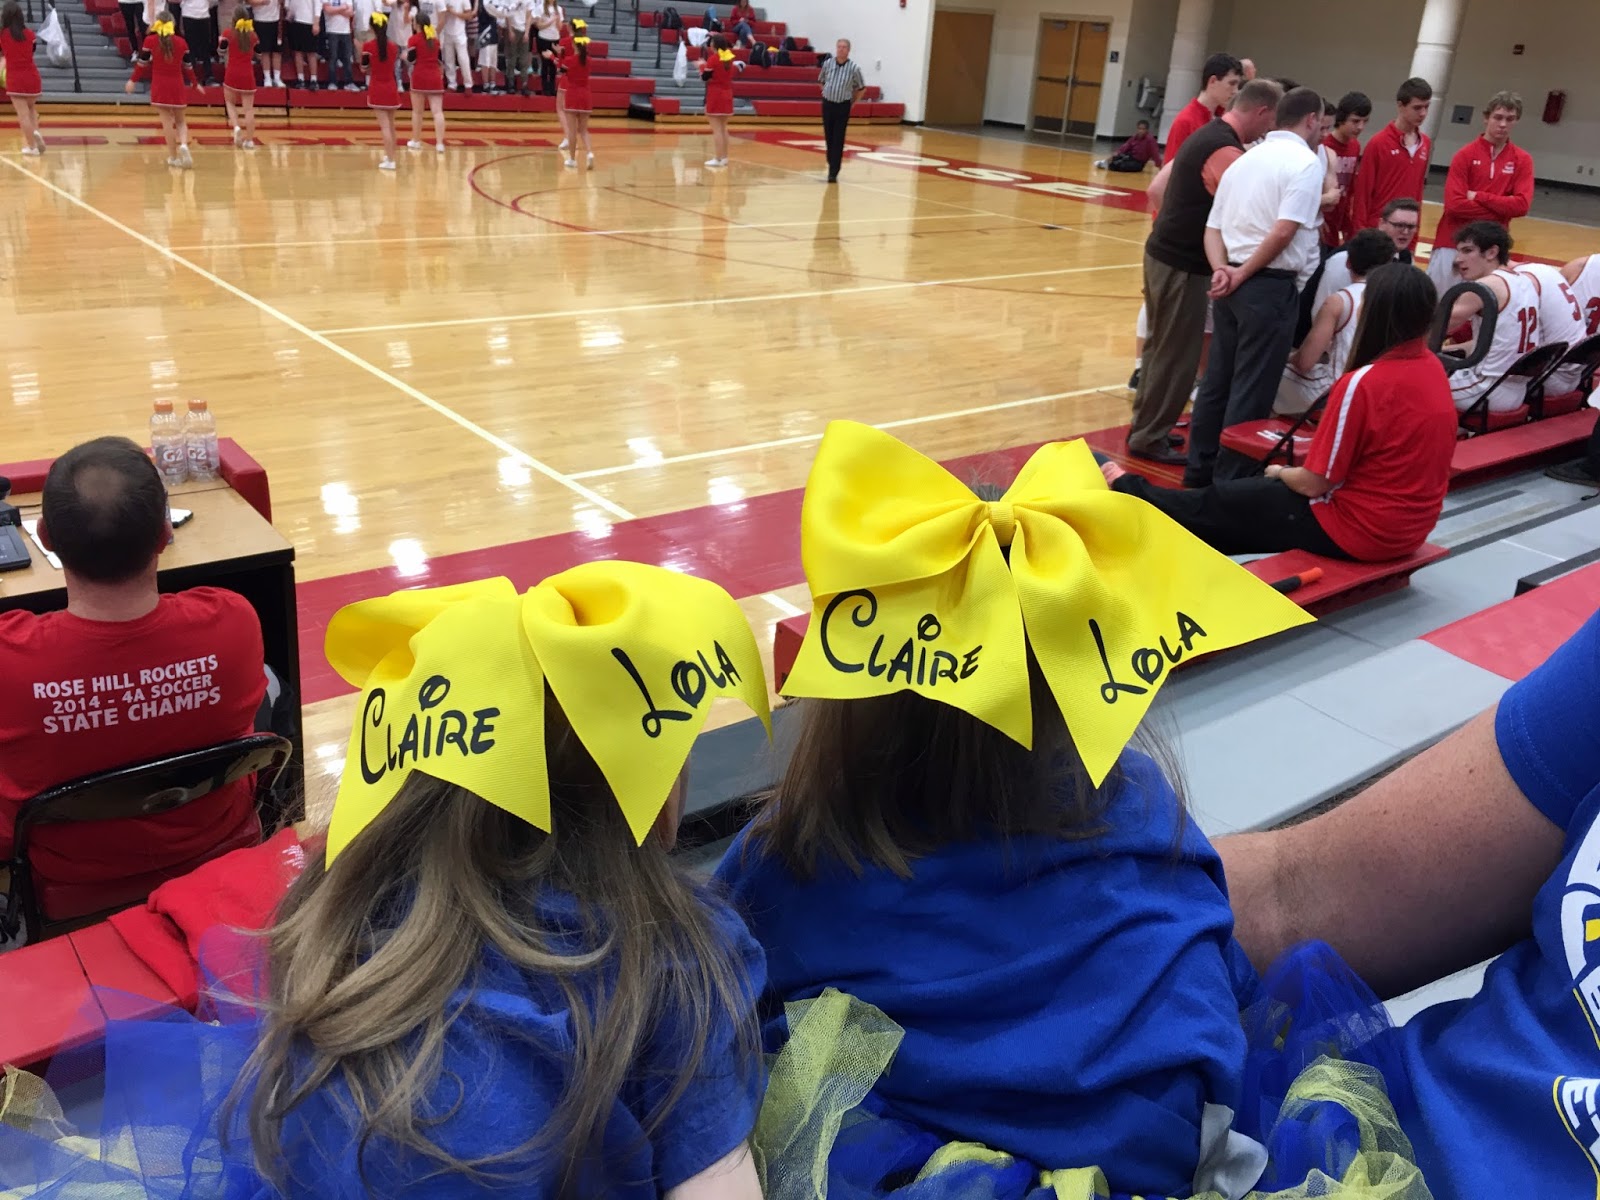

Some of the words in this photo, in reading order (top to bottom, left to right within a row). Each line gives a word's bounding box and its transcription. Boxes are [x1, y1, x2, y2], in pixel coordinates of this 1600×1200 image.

[1558, 283, 1582, 321] 5
[1517, 306, 1539, 354] 12
[163, 448, 184, 462] G2
[187, 447, 207, 460] G2
[33, 679, 86, 699] ROSE
[92, 672, 135, 693] HILL
[139, 654, 219, 685] ROCKETS
[52, 695, 101, 714] 2014
[122, 688, 146, 704] 4A
[151, 674, 212, 699] SOCCER
[43, 707, 120, 734] STATE
[128, 686, 222, 721] CHAMPS
